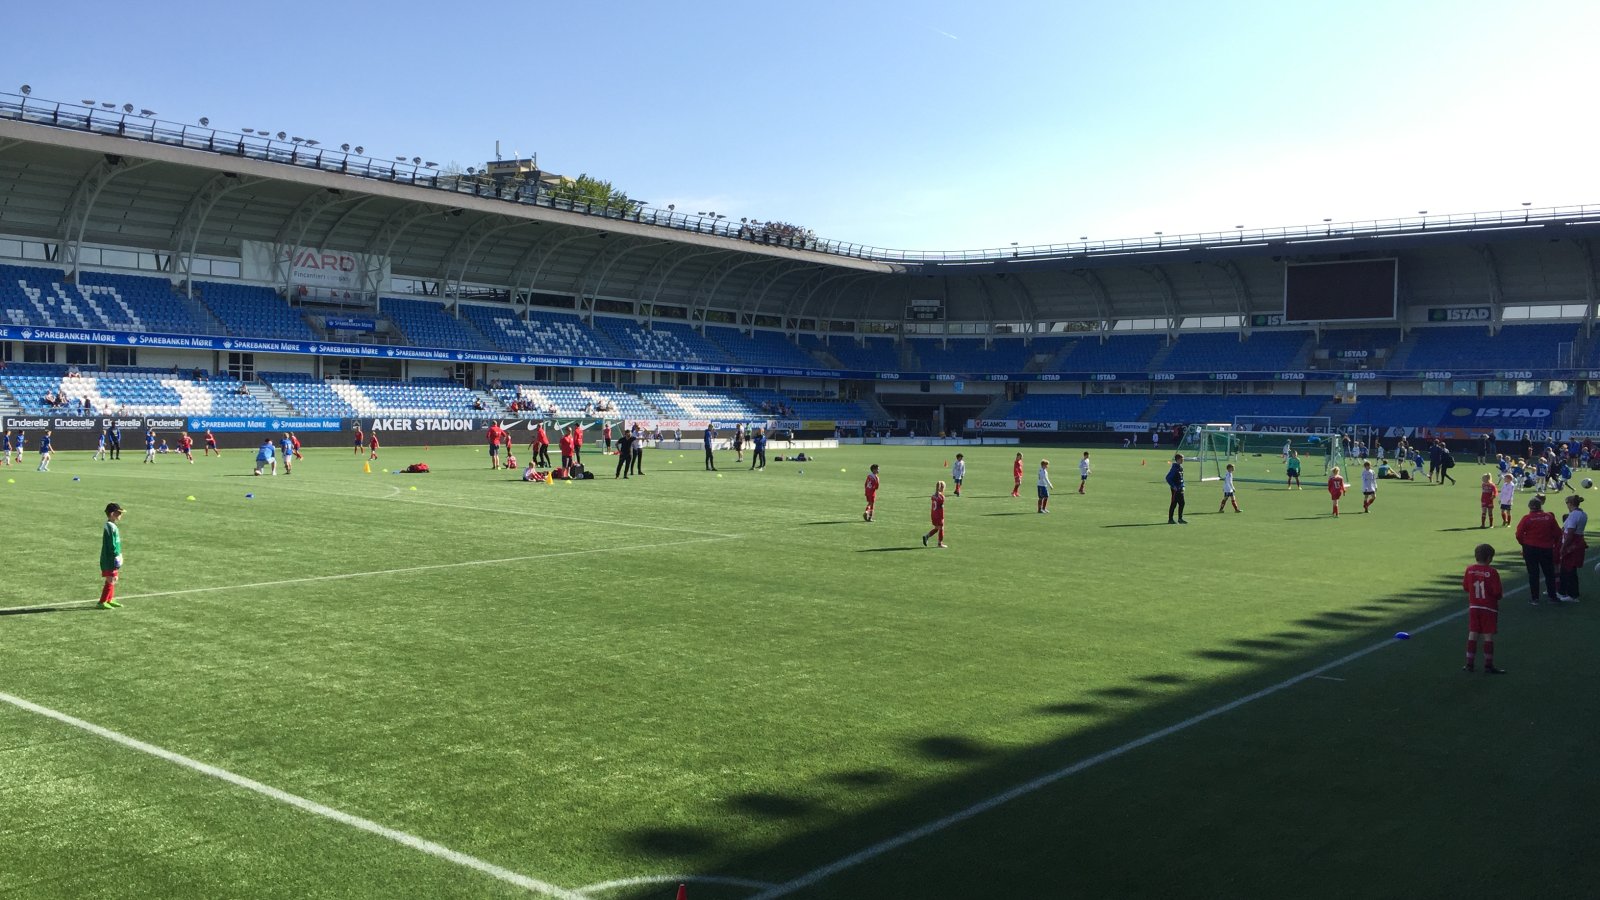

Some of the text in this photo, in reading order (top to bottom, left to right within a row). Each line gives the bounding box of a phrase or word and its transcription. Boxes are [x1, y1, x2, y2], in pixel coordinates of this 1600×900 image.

[293, 271, 326, 280] Fincantieri
[1447, 309, 1490, 321] ISTAD
[34, 329, 116, 342] SPAREBANKEN MØRE
[139, 335, 213, 347] SPAREBANKEN MØRE
[233, 340, 300, 351] SPAREBANKEN MØRE
[319, 344, 379, 355] SPAREBANKEN MØRE
[395, 348, 449, 359] SPAREBANKEN MØRE
[464, 352, 514, 362] SPAREBANKEN MØRE
[527, 356, 572, 365] SPAREBANKEN MØRE
[584, 358, 613, 366] SPAREBANKEN
[1425, 371, 1452, 379] ISTAD
[1504, 371, 1533, 379] ISTAD
[1475, 407, 1551, 418] ISTAD
[7, 418, 49, 427] Cinderella
[54, 418, 95, 427] Cinderella
[146, 418, 184, 427] Cinderella
[201, 420, 267, 428] SPAREBANKEN MØRE
[280, 420, 340, 428] SPAREBANKEN MØRE
[371, 418, 473, 431] AKER STADION
[777, 421, 800, 430] Triangel
[1260, 426, 1310, 434] ANGVIK
[1473, 580, 1487, 599] 11
